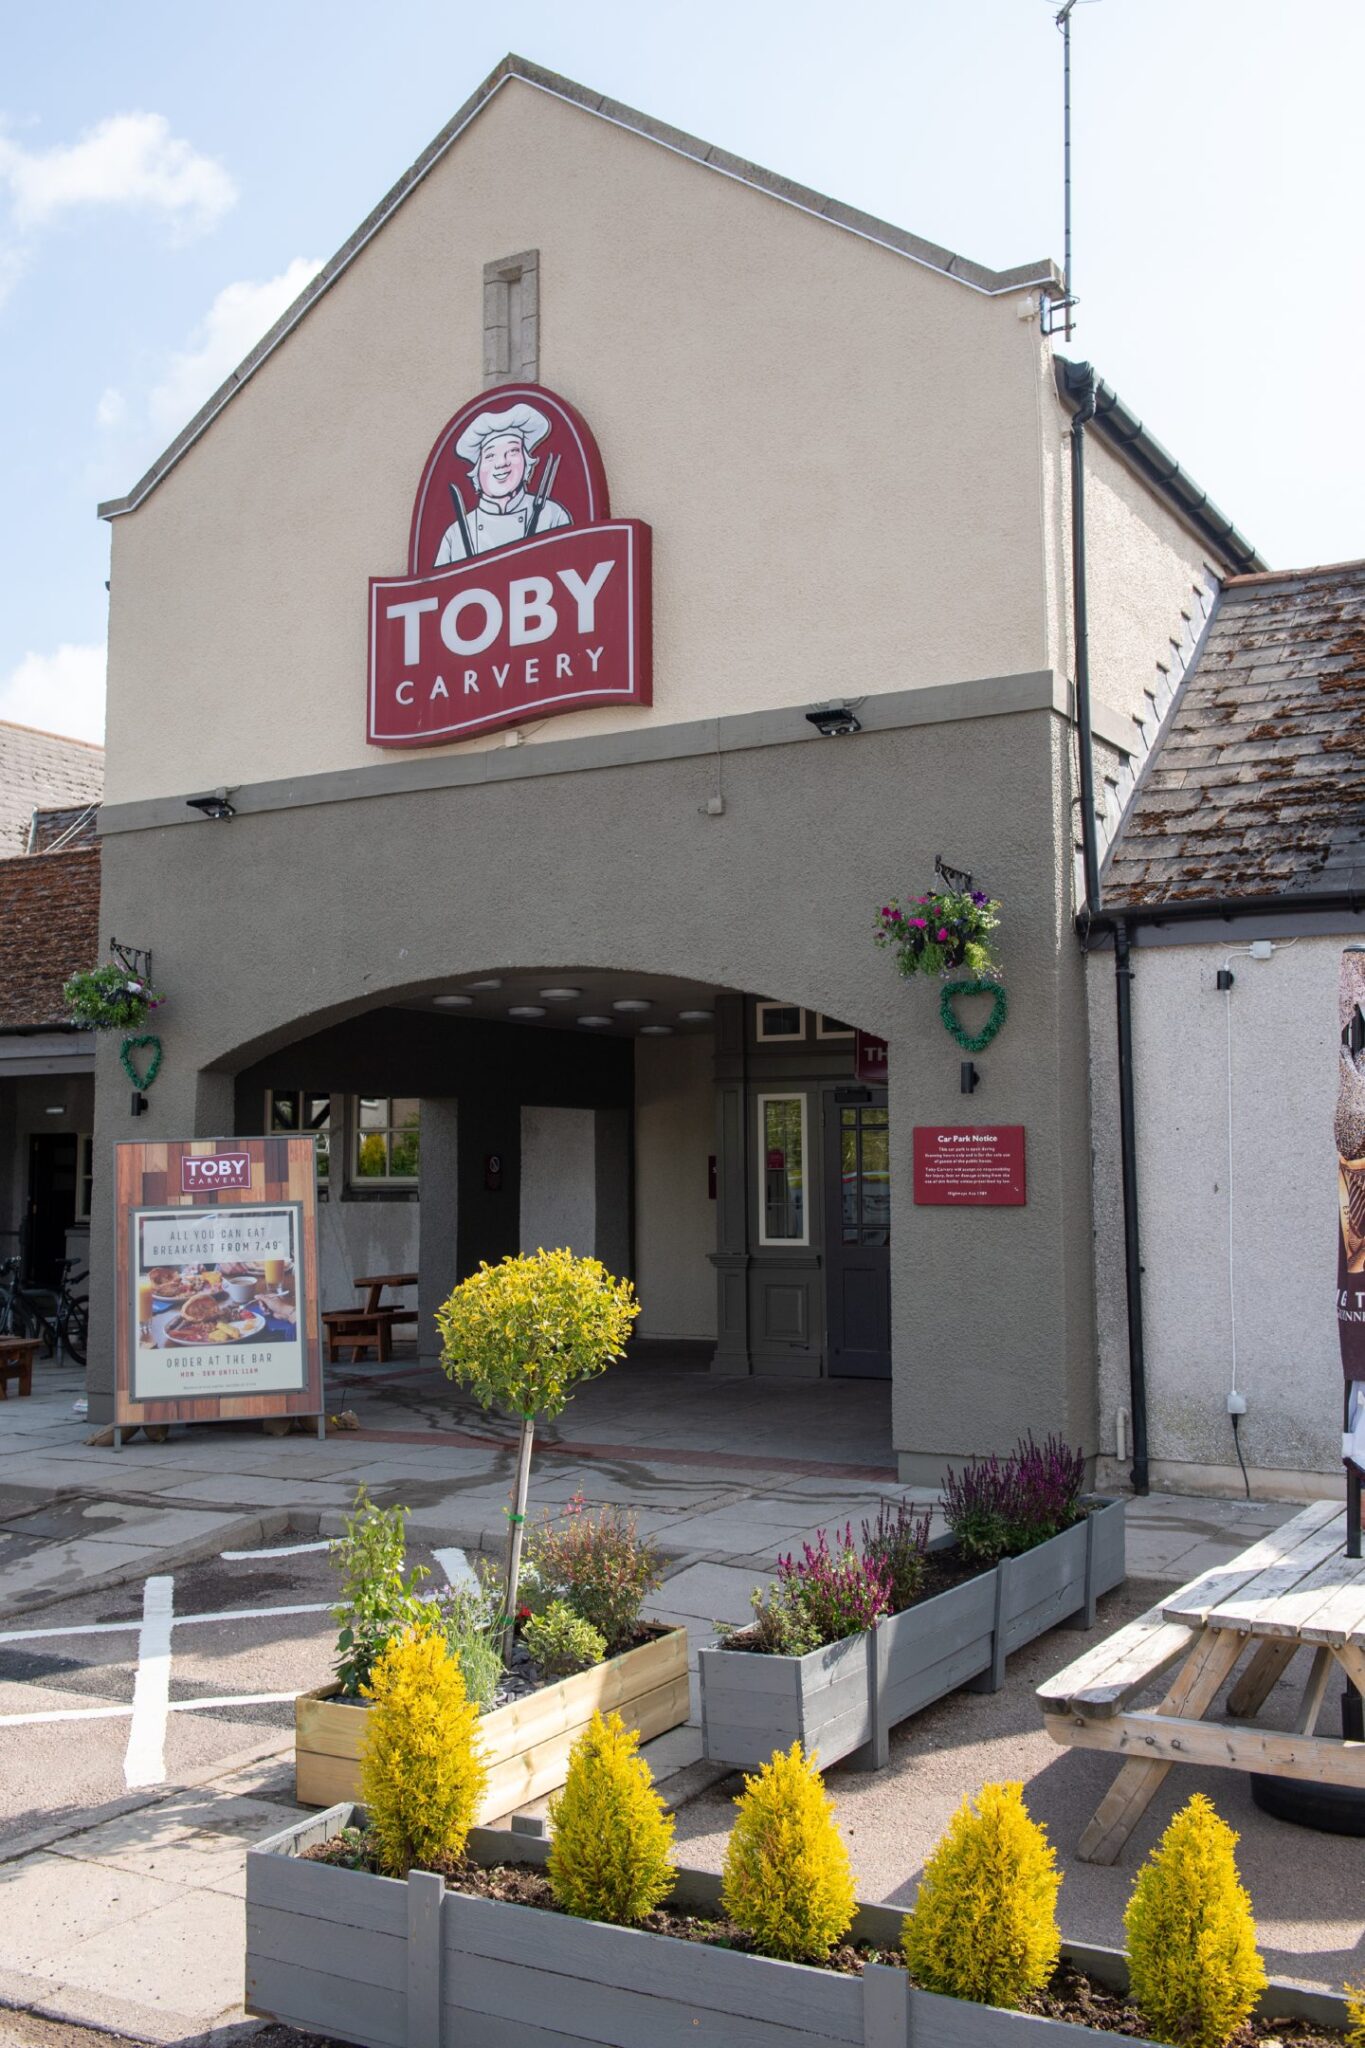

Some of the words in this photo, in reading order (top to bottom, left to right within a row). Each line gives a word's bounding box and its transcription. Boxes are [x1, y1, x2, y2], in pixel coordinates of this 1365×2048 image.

[386, 559, 616, 667] TOBY
[395, 646, 604, 705] CARVERY
[937, 1135, 952, 1143] Car
[953, 1134, 971, 1142] Park
[972, 1134, 998, 1142] Notice
[186, 1159, 245, 1177] TOBY
[189, 1177, 243, 1185] CARVERY
[170, 1231, 188, 1240] ALL
[193, 1230, 215, 1240] YOU
[221, 1229, 241, 1239] CAN
[247, 1228, 265, 1238] EAT
[153, 1243, 214, 1255] BREAKFAST
[221, 1242, 249, 1252] FROM
[166, 1357, 202, 1368] ORDER
[208, 1355, 220, 1365] AT
[226, 1354, 245, 1364] THE
[252, 1353, 272, 1363] BAR
